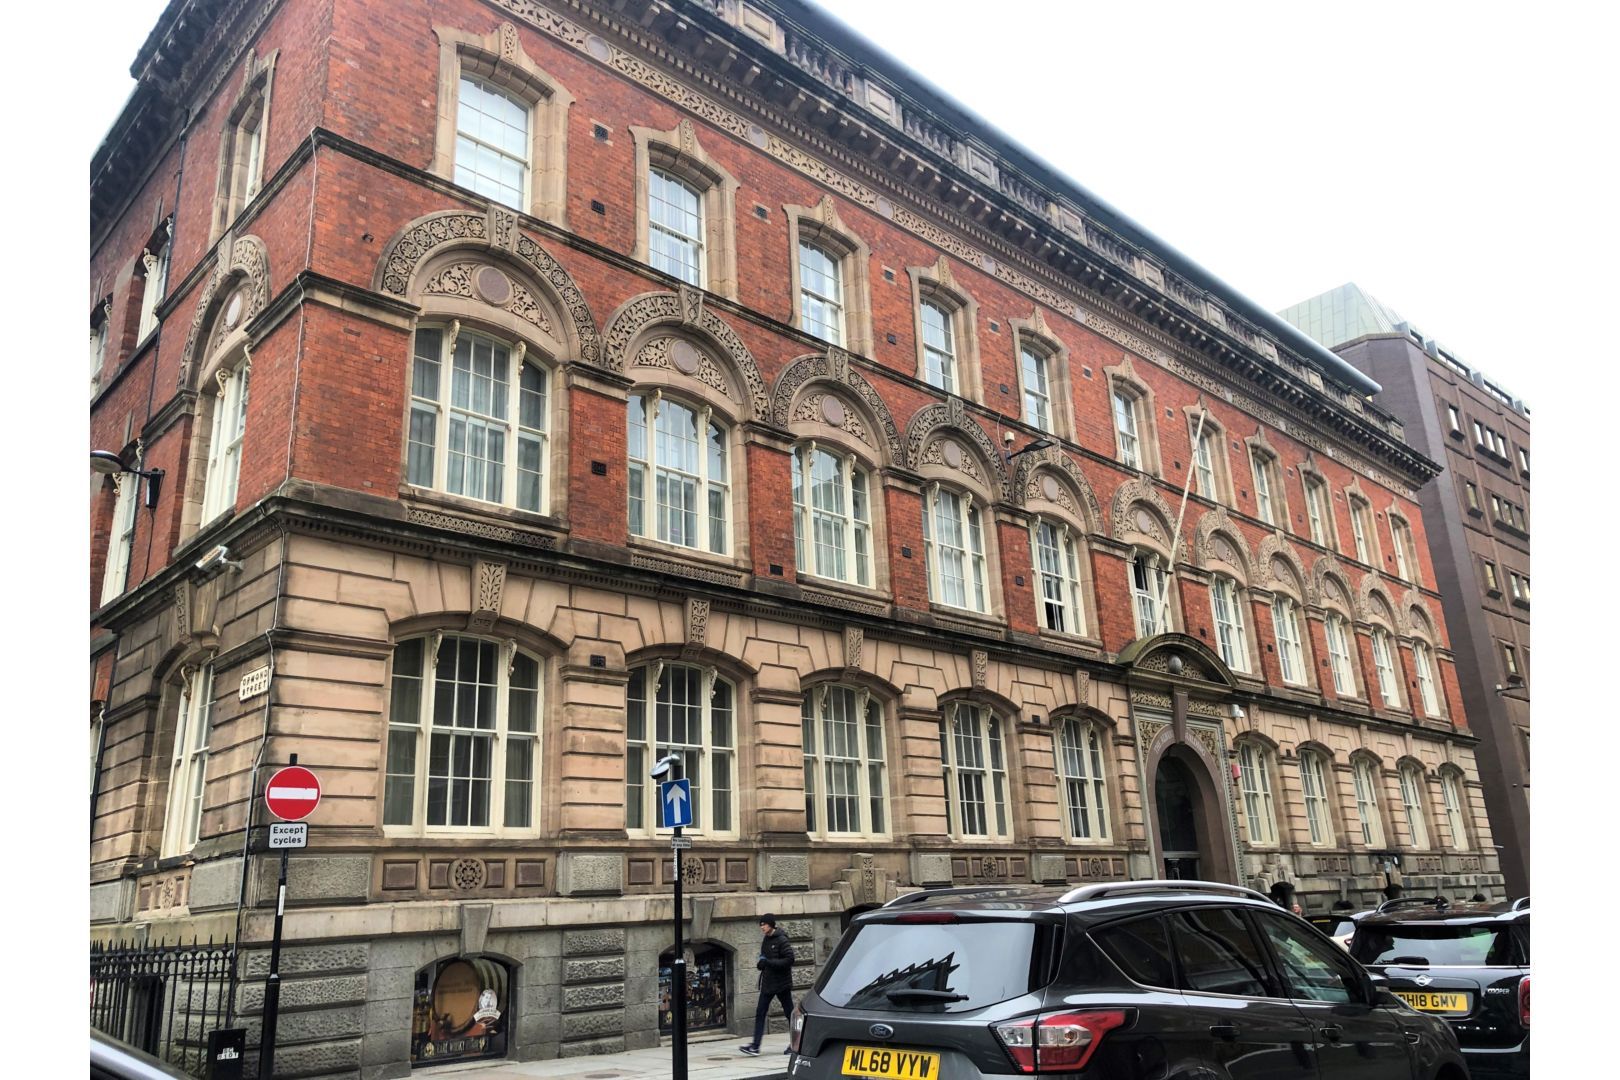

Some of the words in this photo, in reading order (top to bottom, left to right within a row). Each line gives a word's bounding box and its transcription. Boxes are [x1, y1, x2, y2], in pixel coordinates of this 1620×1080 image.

[242, 669, 268, 686] ORMOND
[242, 679, 267, 697] STREET
[273, 826, 304, 835] Except
[273, 836, 302, 846] cycles
[1487, 987, 1511, 995] COOPER
[1431, 994, 1458, 1008] GMV
[849, 1049, 892, 1074] ML68
[896, 1052, 932, 1078] VYW
